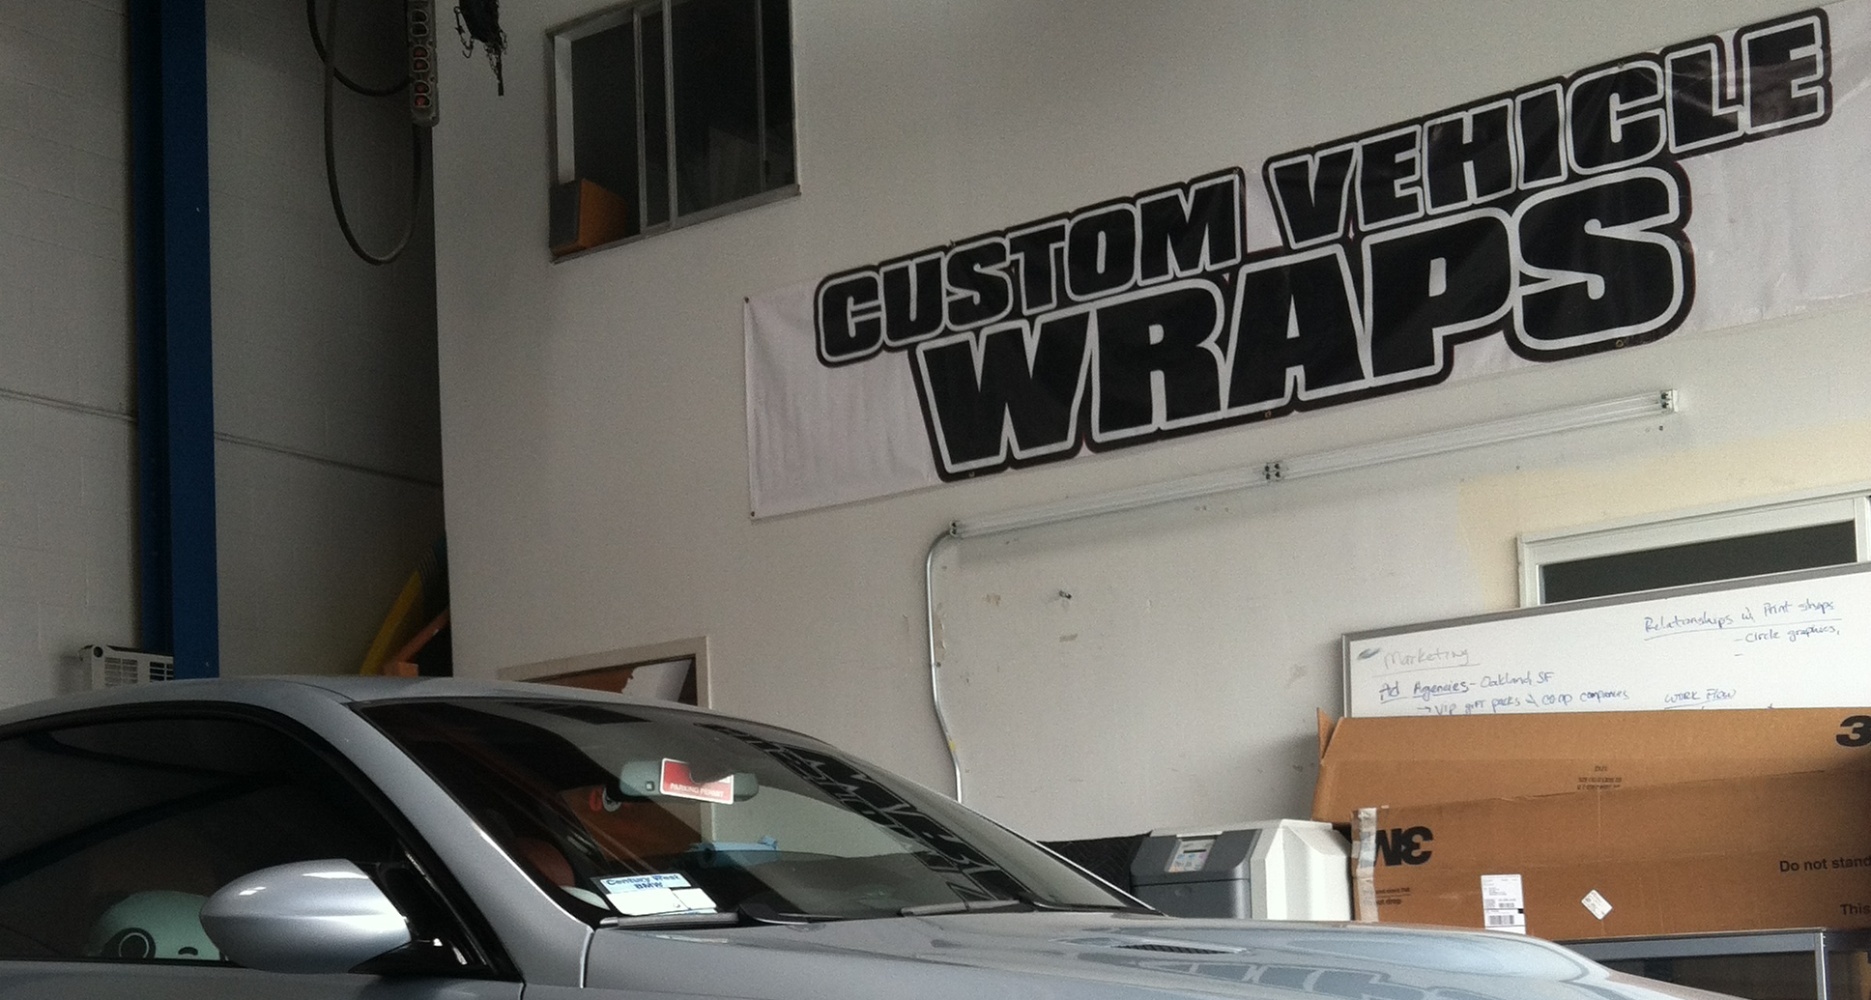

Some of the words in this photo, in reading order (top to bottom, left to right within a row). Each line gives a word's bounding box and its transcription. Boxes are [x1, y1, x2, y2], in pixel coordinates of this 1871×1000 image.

[817, 170, 1243, 364] CUSTOM
[1265, 12, 1829, 250] VEHICLE
[913, 165, 1688, 476] WRAPS
[1383, 647, 1470, 669] Marketing
[1379, 681, 1401, 701] Ad
[1536, 671, 1555, 684] SF
[1779, 859, 1800, 873] Do
[1803, 857, 1828, 871] not
[1832, 855, 1871, 869] stand
[1839, 902, 1871, 917] This
